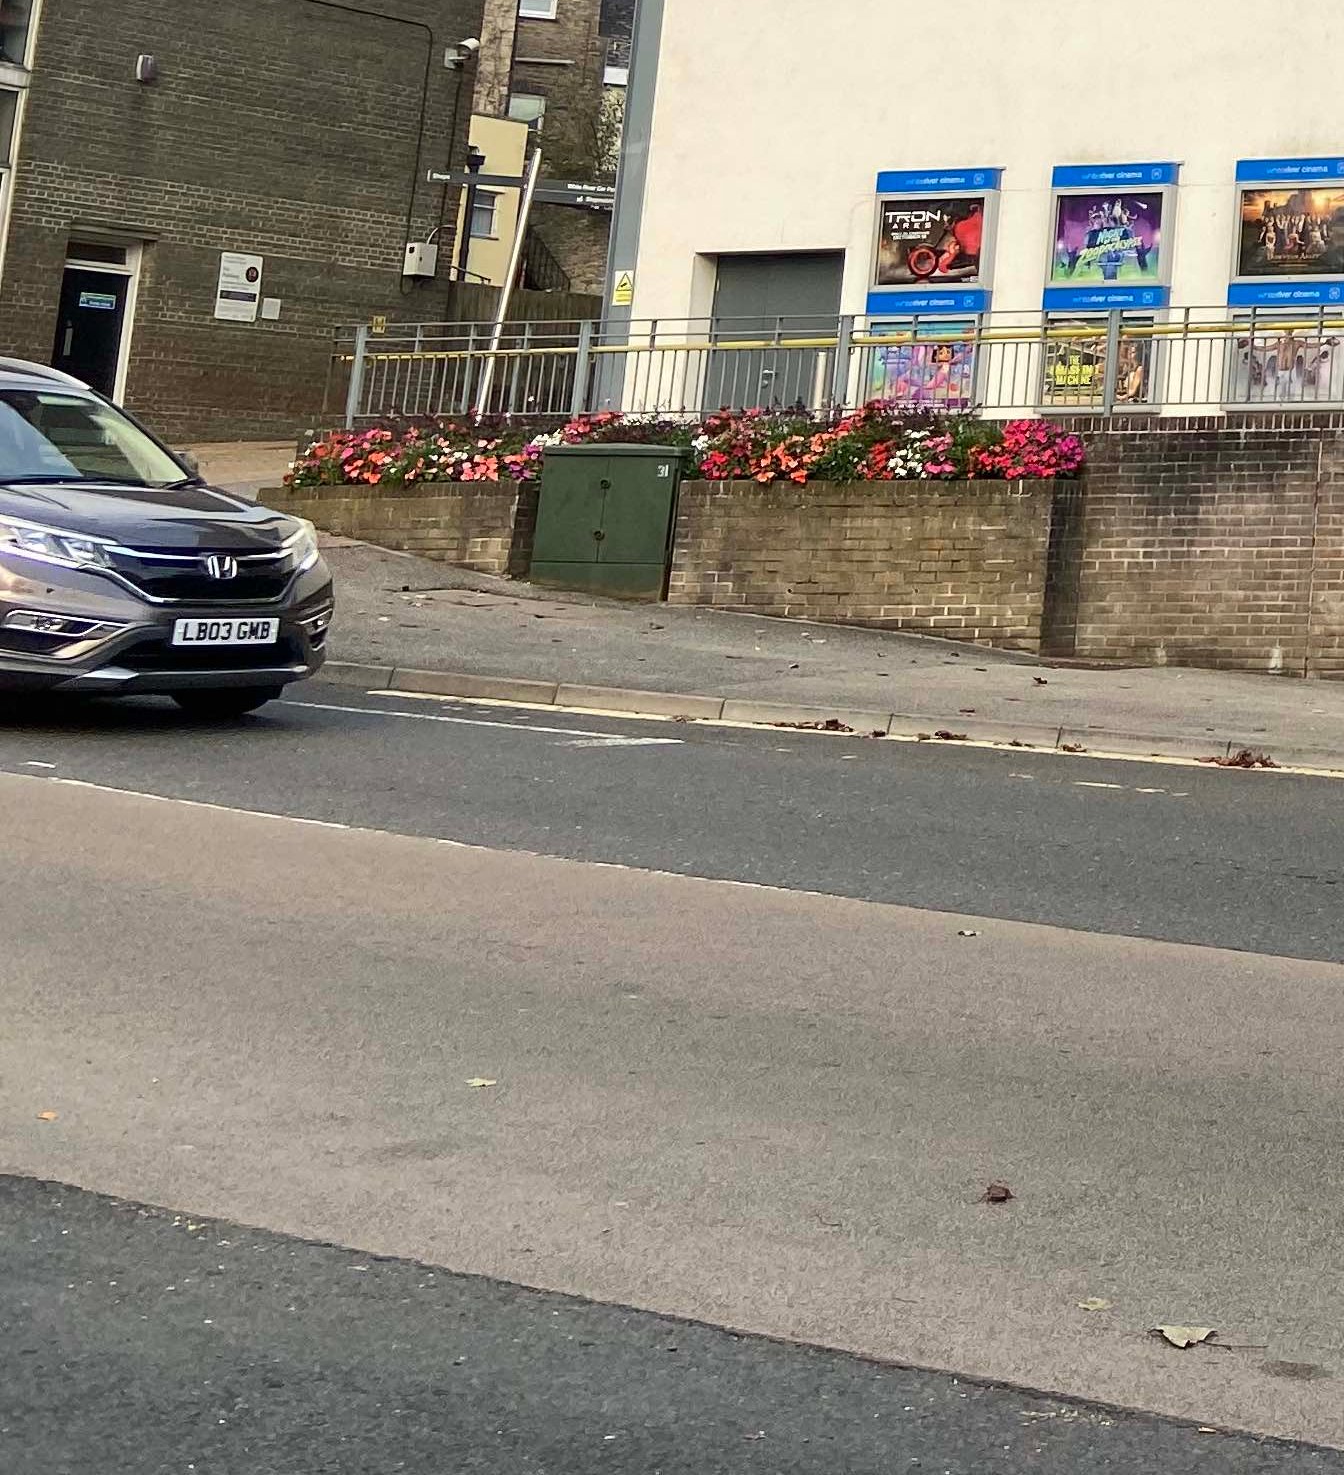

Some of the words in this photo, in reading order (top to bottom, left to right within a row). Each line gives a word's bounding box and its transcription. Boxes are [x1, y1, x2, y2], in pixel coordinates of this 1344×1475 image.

[884, 209, 941, 223] TRON
[891, 222, 932, 230] ARES
[182, 621, 232, 641] LB03
[236, 621, 271, 640] GMB
